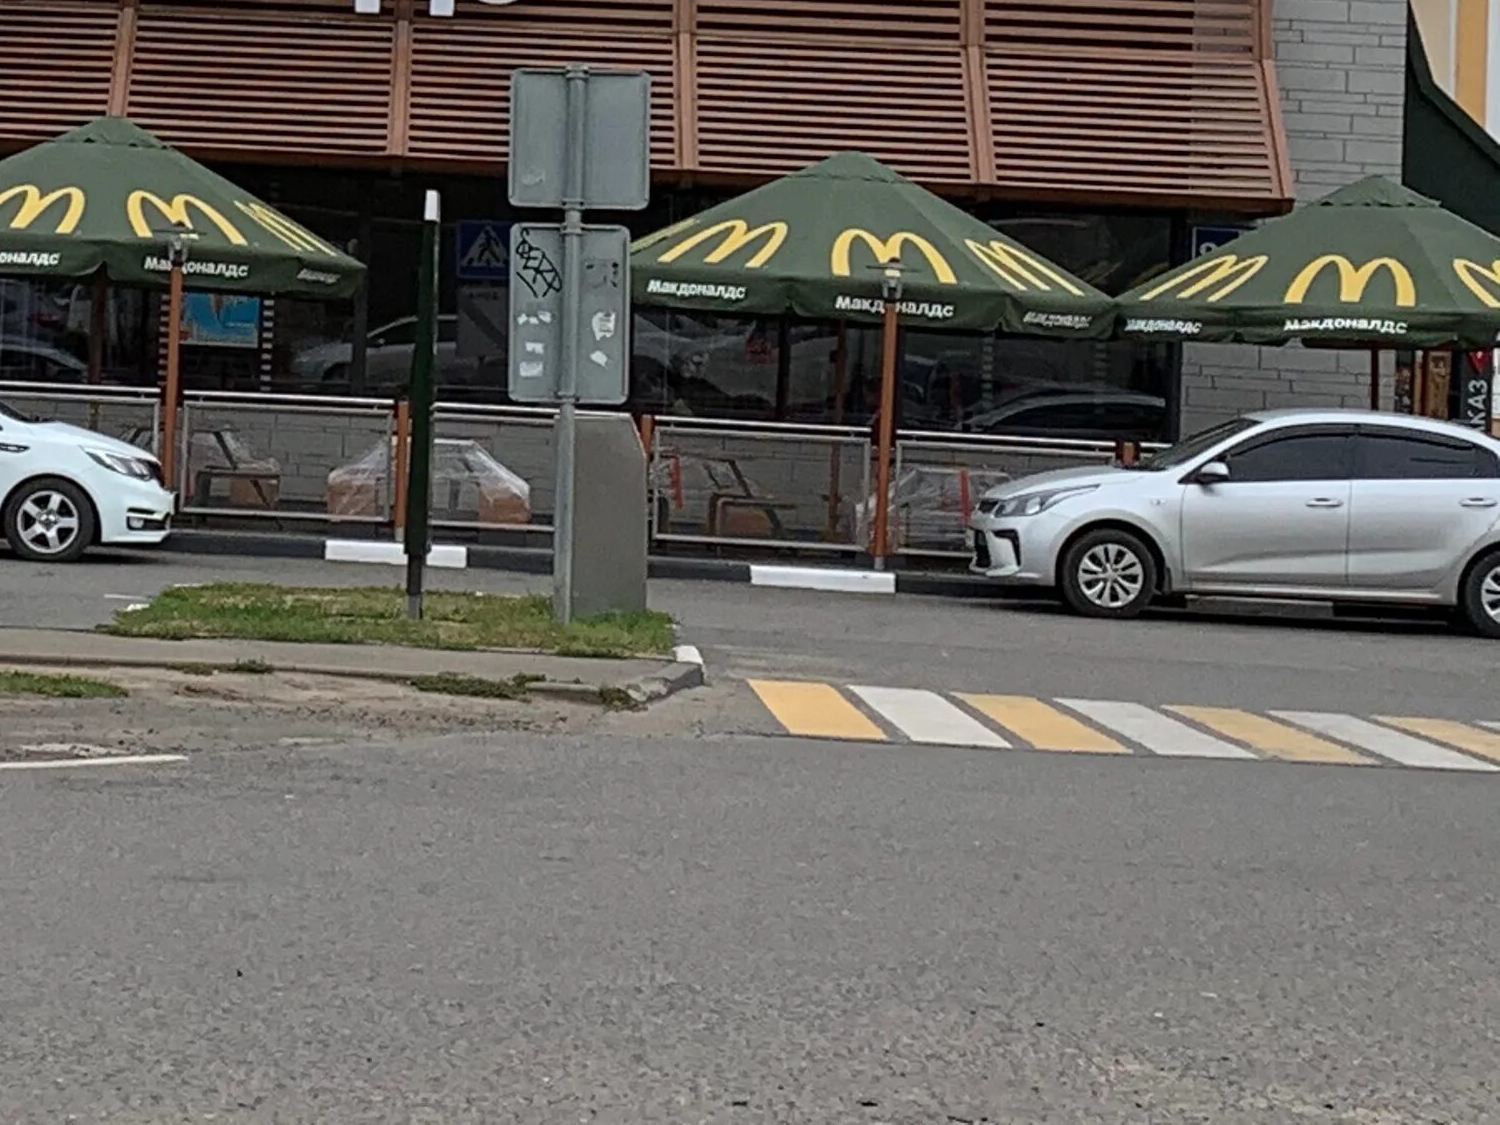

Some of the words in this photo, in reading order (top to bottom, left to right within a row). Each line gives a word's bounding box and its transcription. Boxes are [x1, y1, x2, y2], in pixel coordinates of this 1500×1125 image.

[646, 279, 748, 300] Макдоналдс
[835, 295, 955, 318] Макдналдс
[1283, 317, 1408, 335] Макдоналдс
